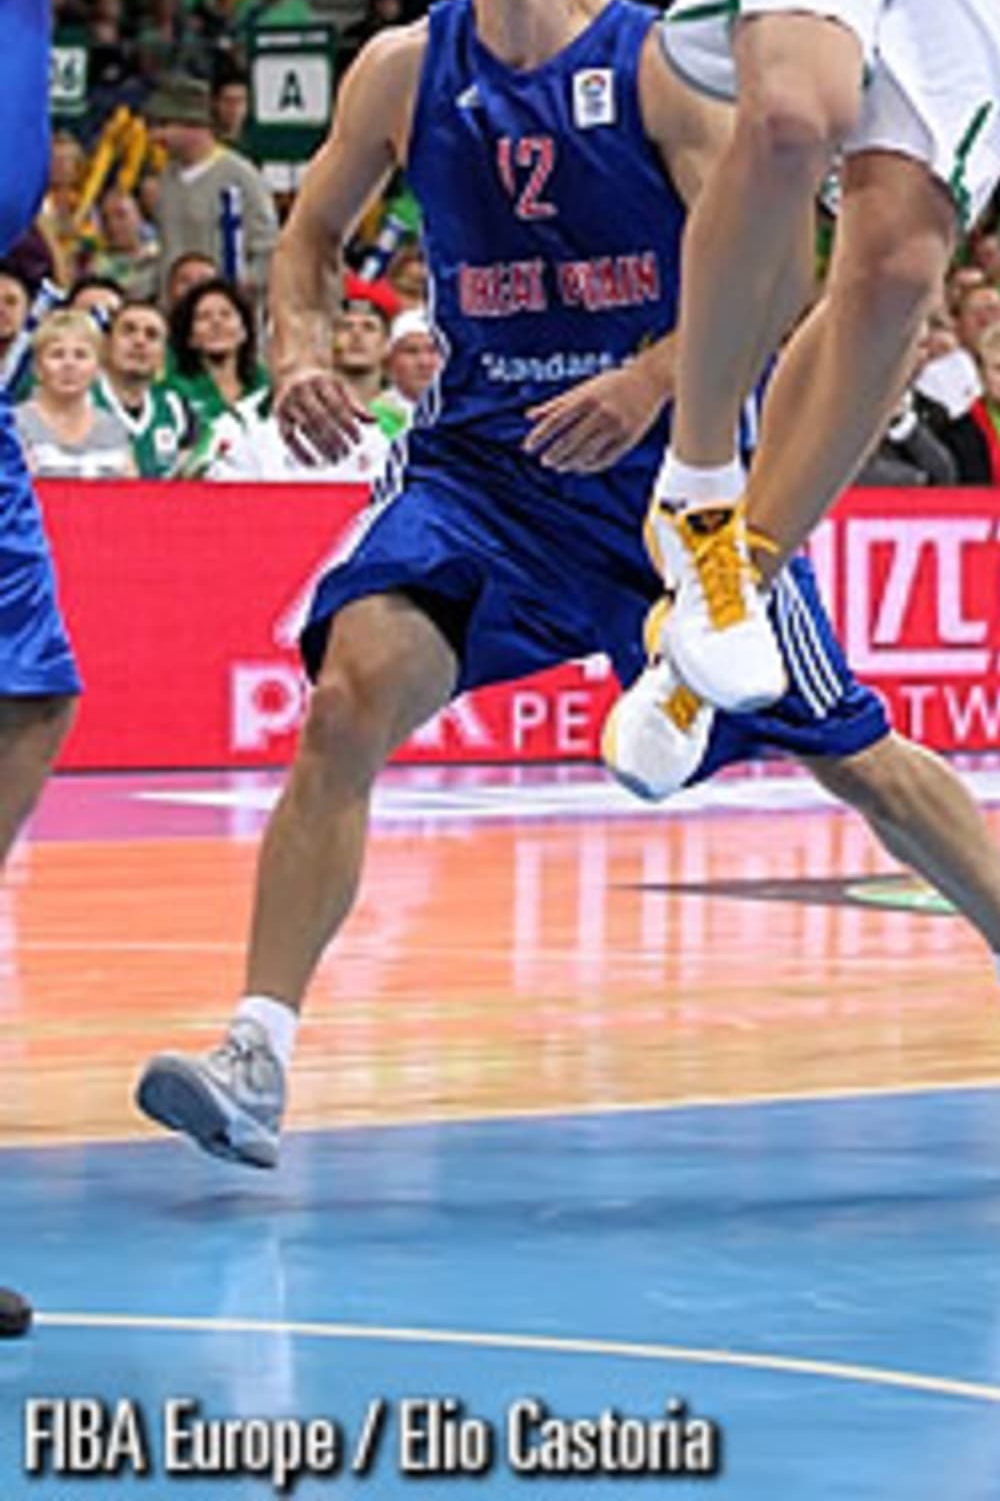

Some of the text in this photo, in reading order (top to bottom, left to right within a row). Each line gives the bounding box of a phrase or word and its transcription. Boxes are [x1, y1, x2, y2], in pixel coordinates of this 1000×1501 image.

[277, 69, 304, 111] A
[497, 136, 558, 220] 12
[560, 250, 661, 311] BAIN
[512, 691, 593, 752] PE
